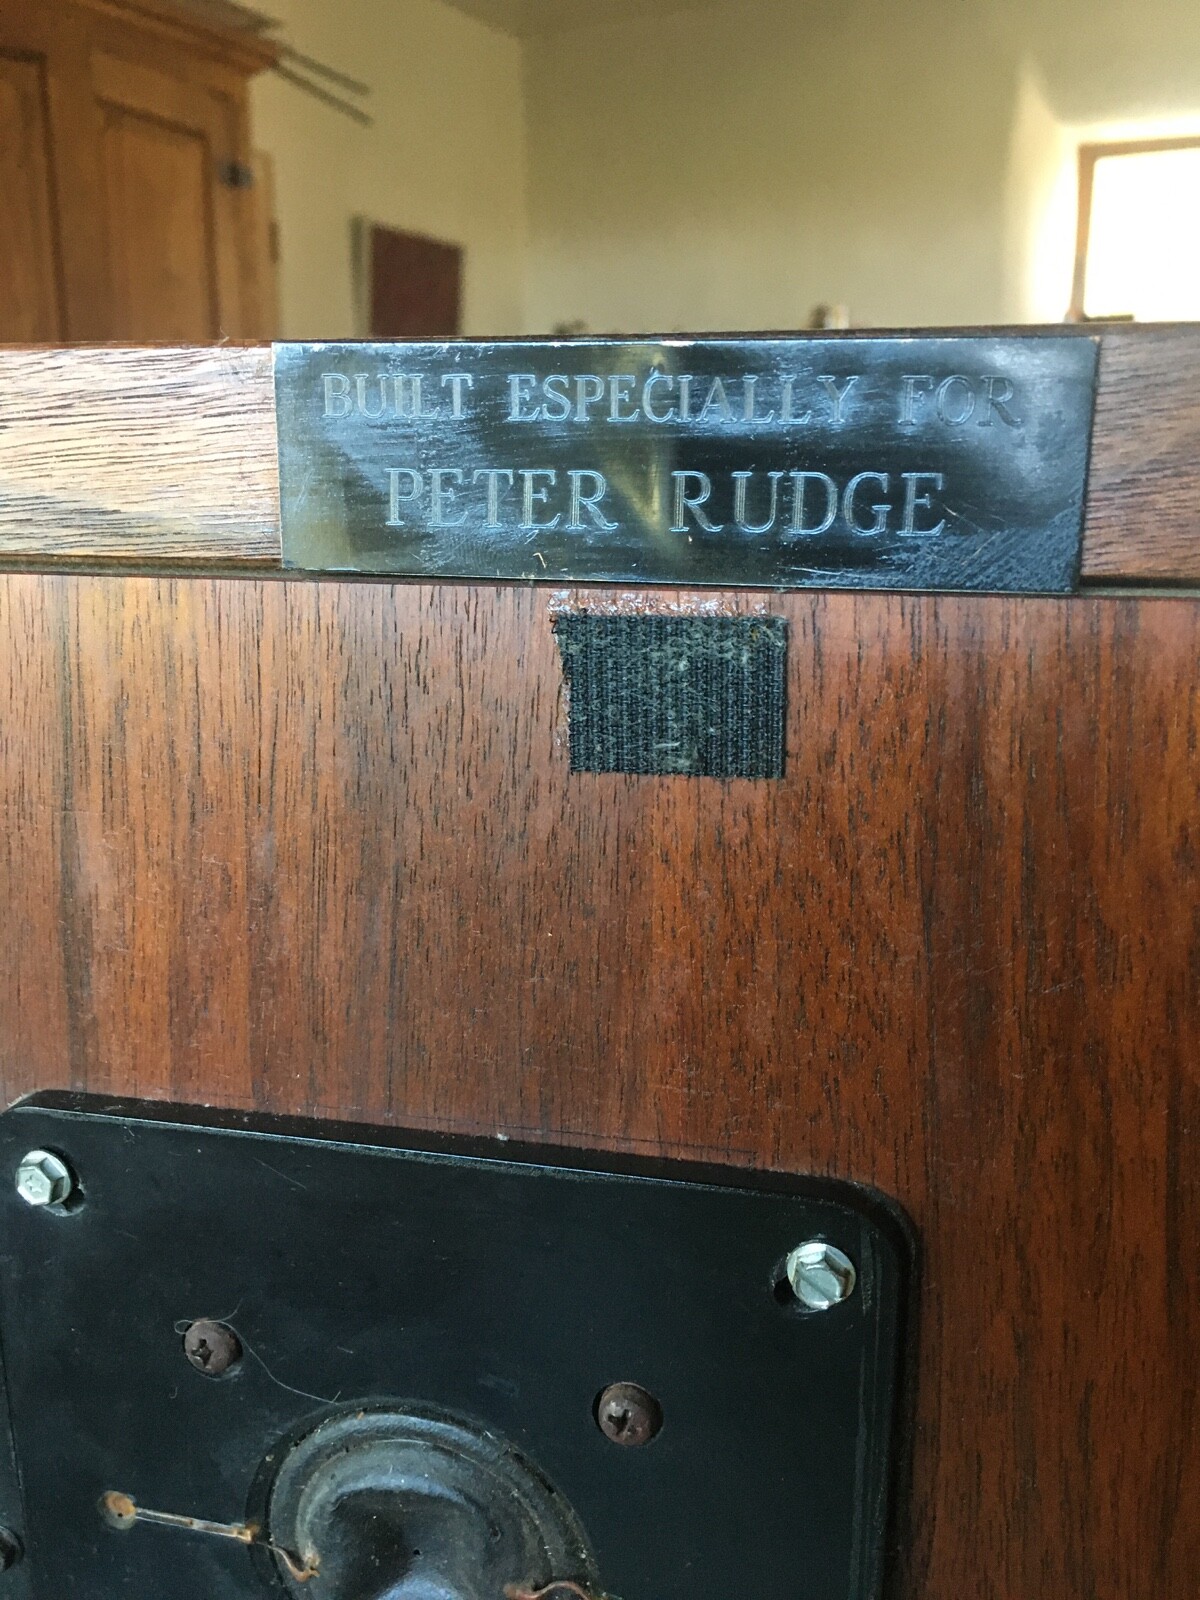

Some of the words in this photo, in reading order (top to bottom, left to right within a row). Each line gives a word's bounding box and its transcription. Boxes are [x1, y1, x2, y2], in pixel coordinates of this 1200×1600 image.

[320, 372, 474, 421] BUILT
[506, 373, 860, 424] ESPECIALLY
[897, 374, 1024, 428] FOR
[384, 467, 619, 531] PETER
[668, 470, 946, 538] RUDGE
